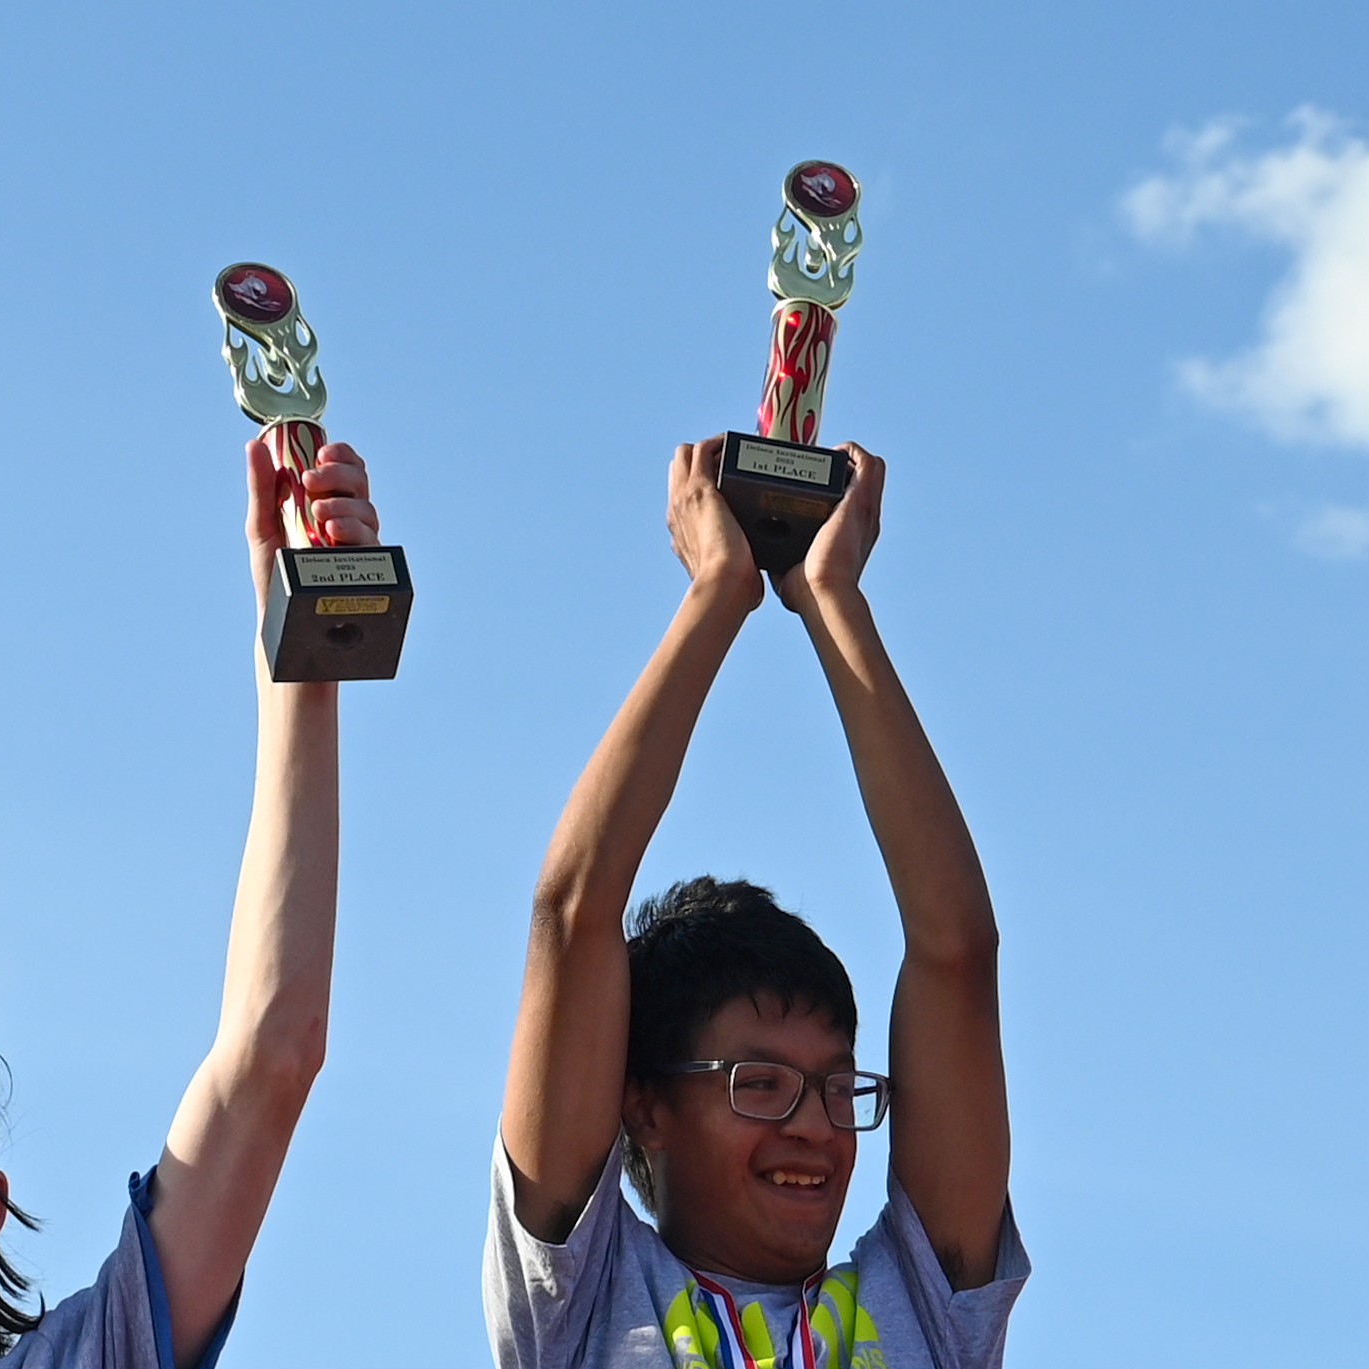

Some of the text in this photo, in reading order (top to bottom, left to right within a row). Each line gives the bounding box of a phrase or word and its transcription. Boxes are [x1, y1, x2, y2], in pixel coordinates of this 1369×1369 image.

[753, 461, 817, 479] 1st PLACE
[311, 572, 385, 582] 2nd PLACE
